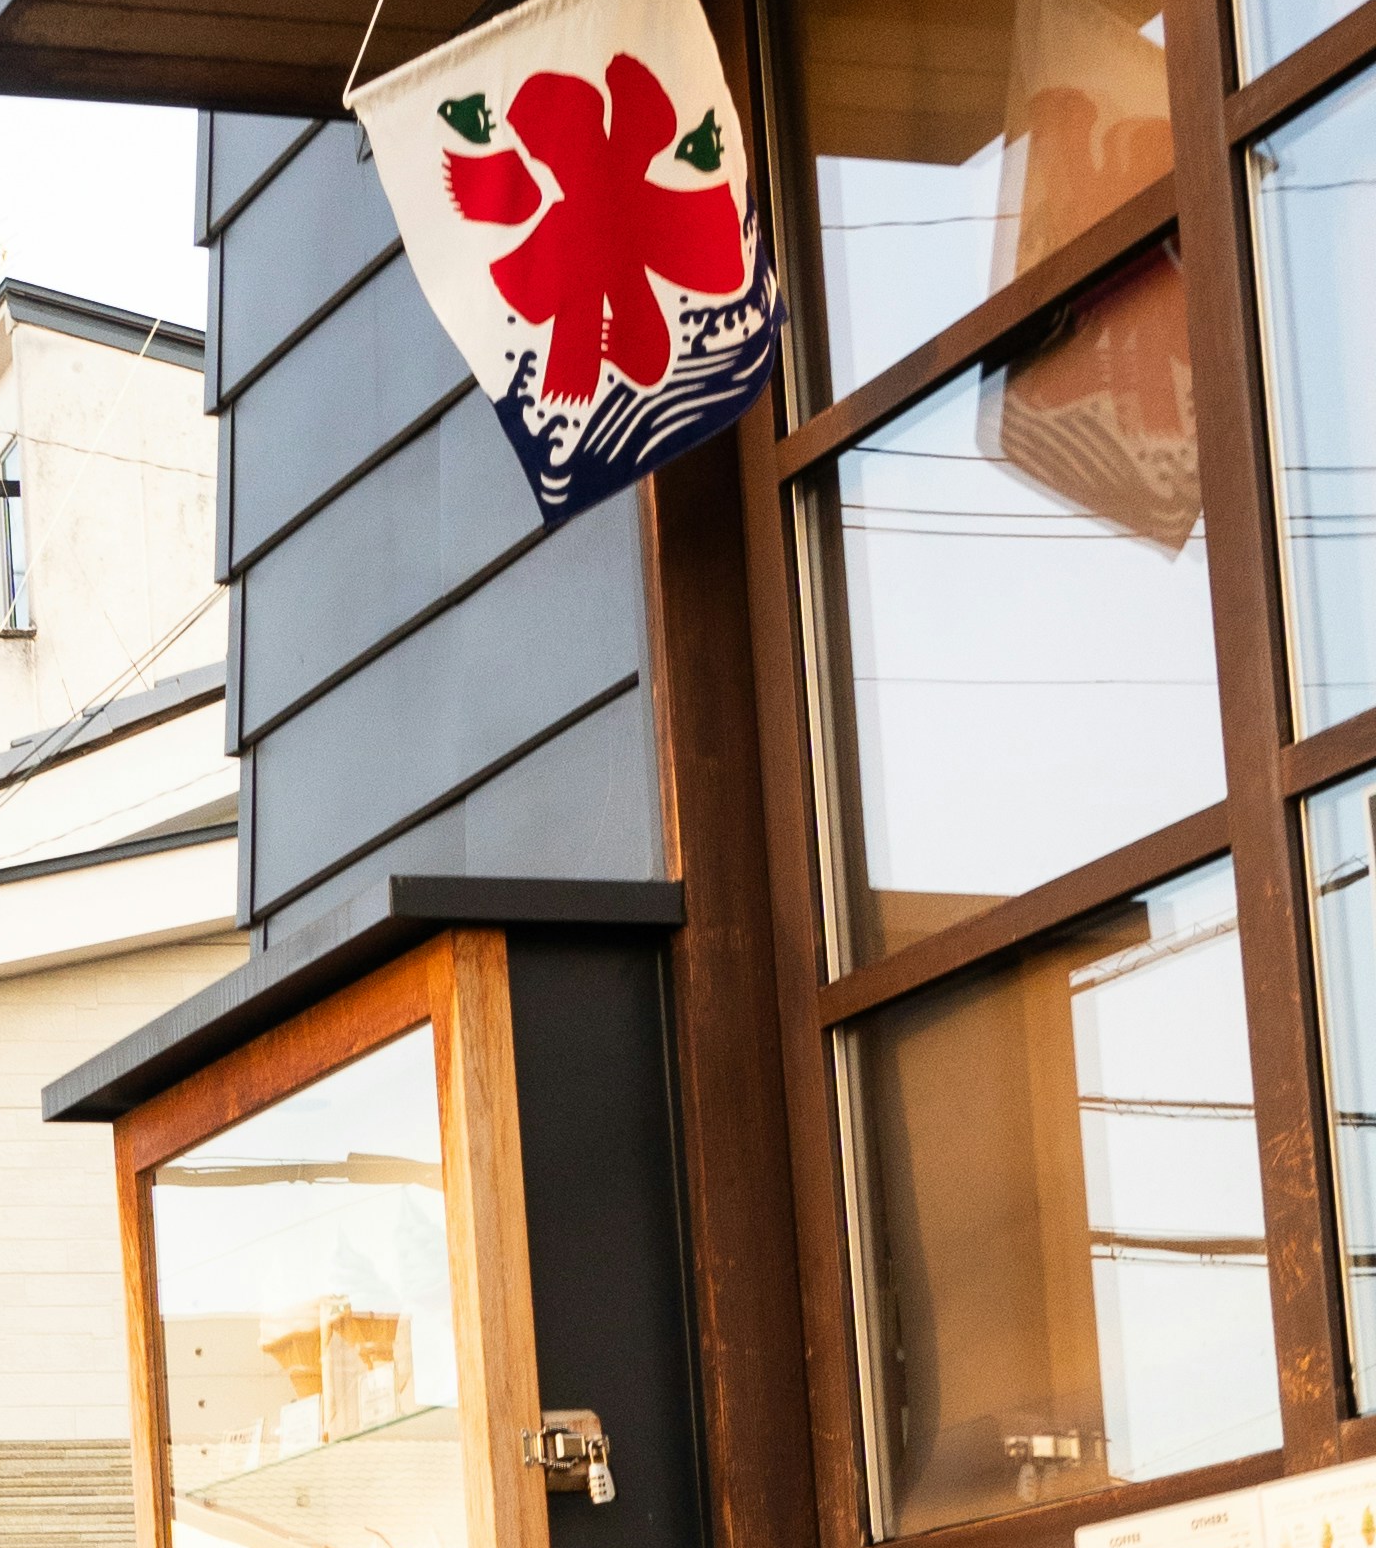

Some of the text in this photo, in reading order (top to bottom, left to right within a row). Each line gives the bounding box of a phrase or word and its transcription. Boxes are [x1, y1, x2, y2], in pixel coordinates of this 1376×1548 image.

[441, 53, 747, 409] 氷
[1190, 1512, 1230, 1530] OTHERS
[1108, 1532, 1142, 1548] COFFEE
